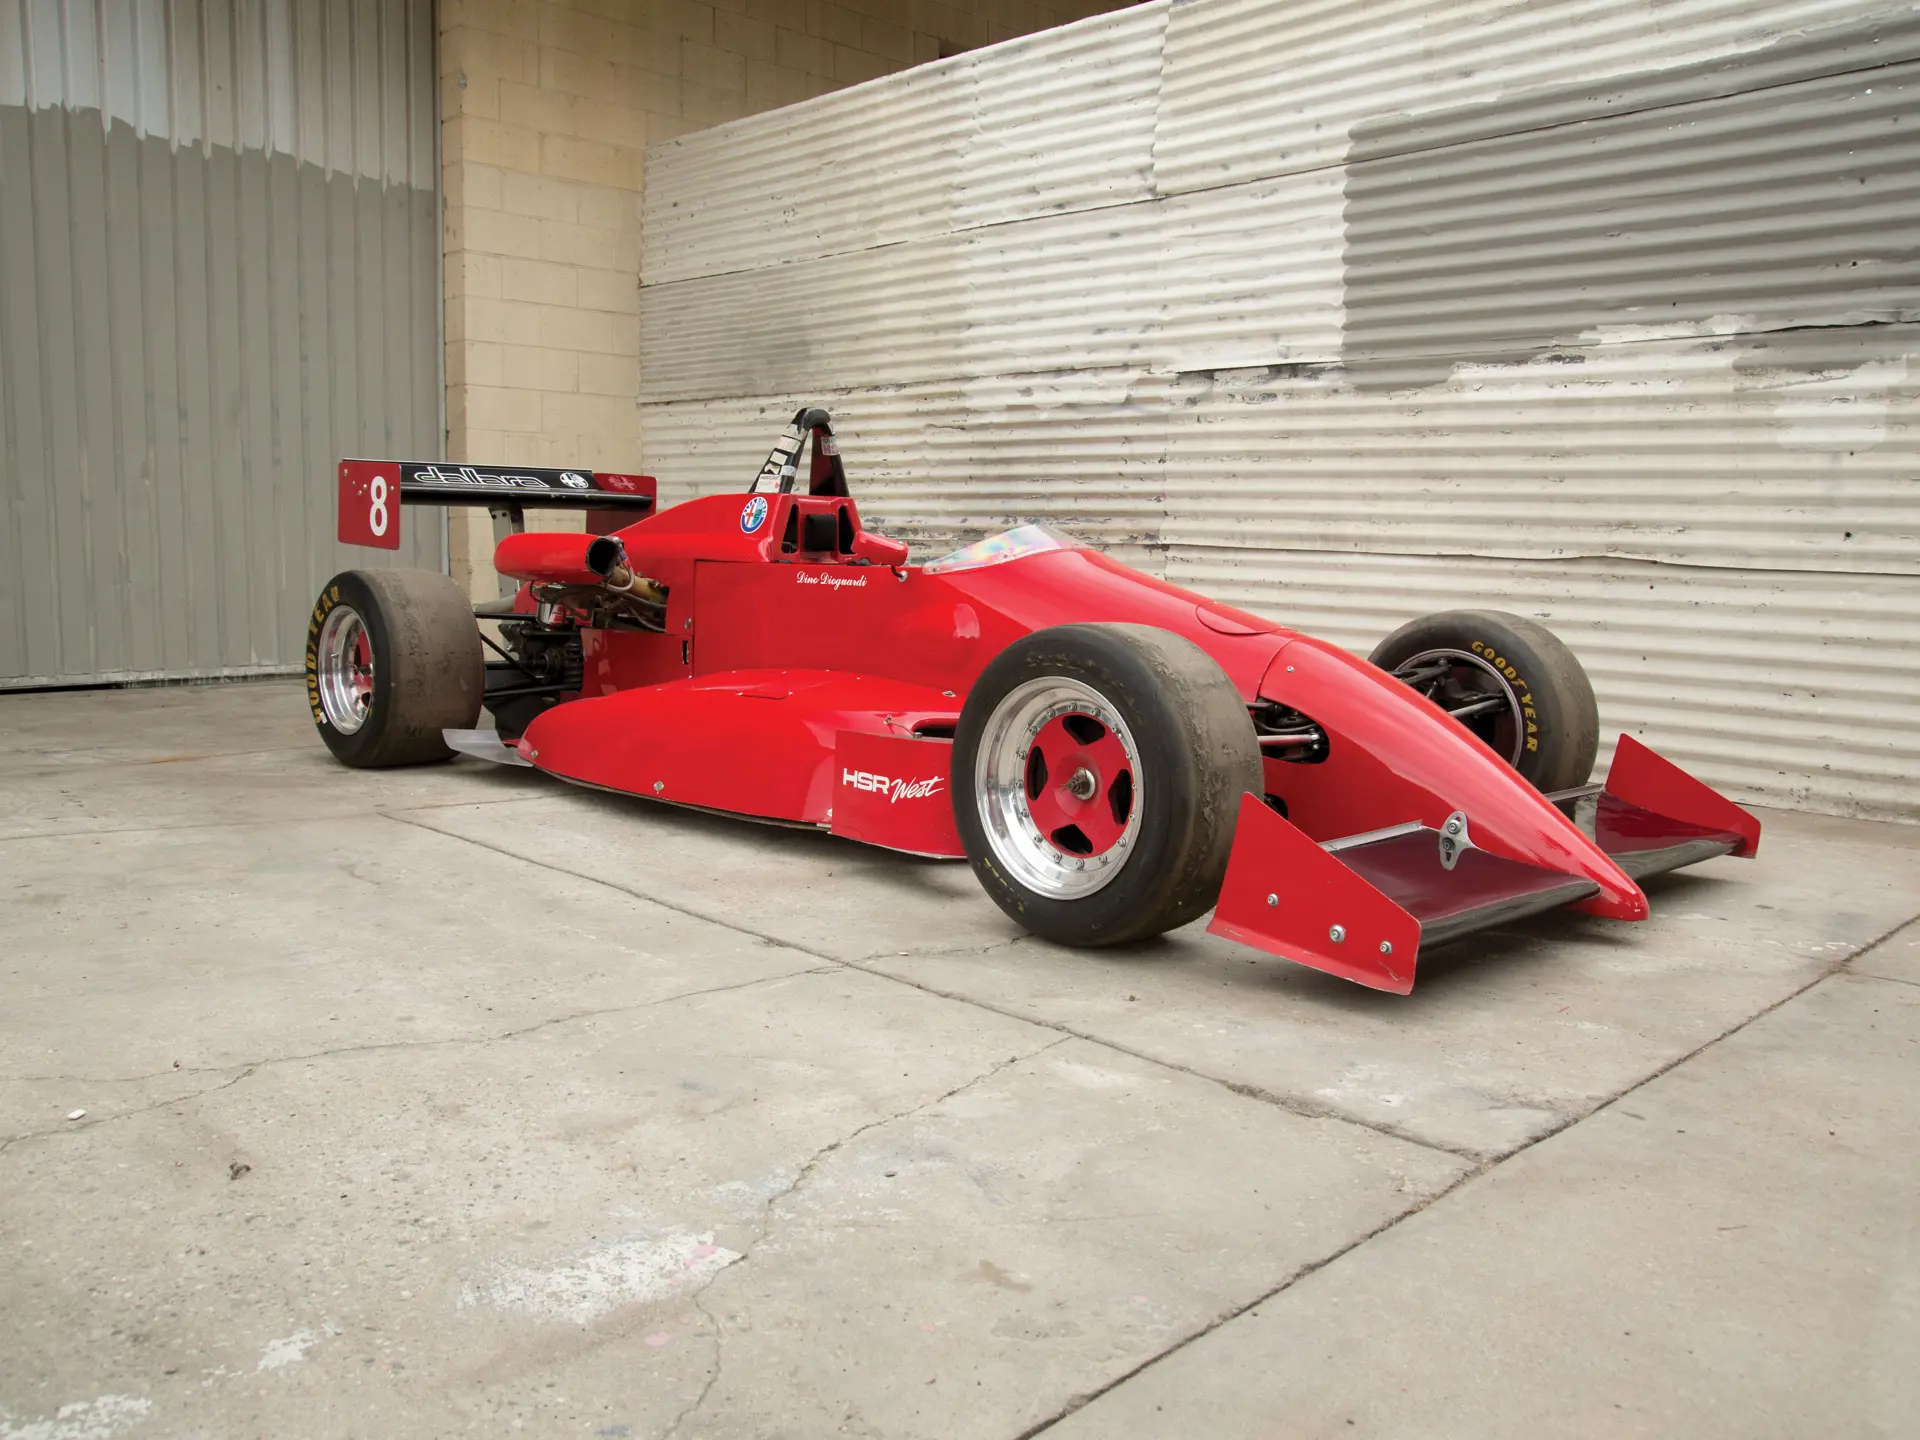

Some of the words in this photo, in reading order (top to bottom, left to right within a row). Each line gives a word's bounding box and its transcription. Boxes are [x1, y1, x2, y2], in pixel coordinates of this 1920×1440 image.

[414, 466, 550, 488] dallara
[369, 475, 388, 537] 8
[796, 570, 820, 585] Dino
[843, 767, 890, 795] HSR
[890, 775, 945, 804] West
